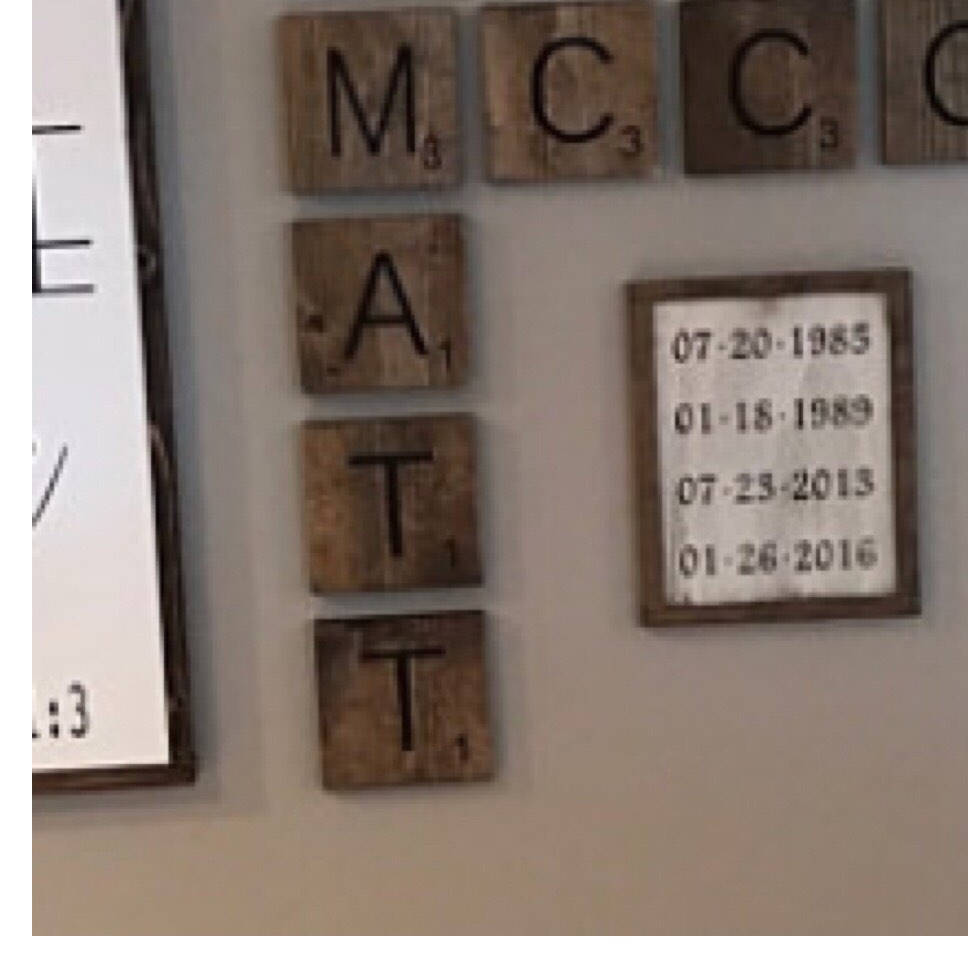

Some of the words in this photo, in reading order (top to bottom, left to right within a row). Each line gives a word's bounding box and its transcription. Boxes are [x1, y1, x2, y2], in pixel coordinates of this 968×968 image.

[622, 124, 643, 158] 3
[819, 116, 840, 150] 3
[439, 339, 452, 374] 1
[32, 680, 91, 739] :3
[455, 732, 469, 763] 1
